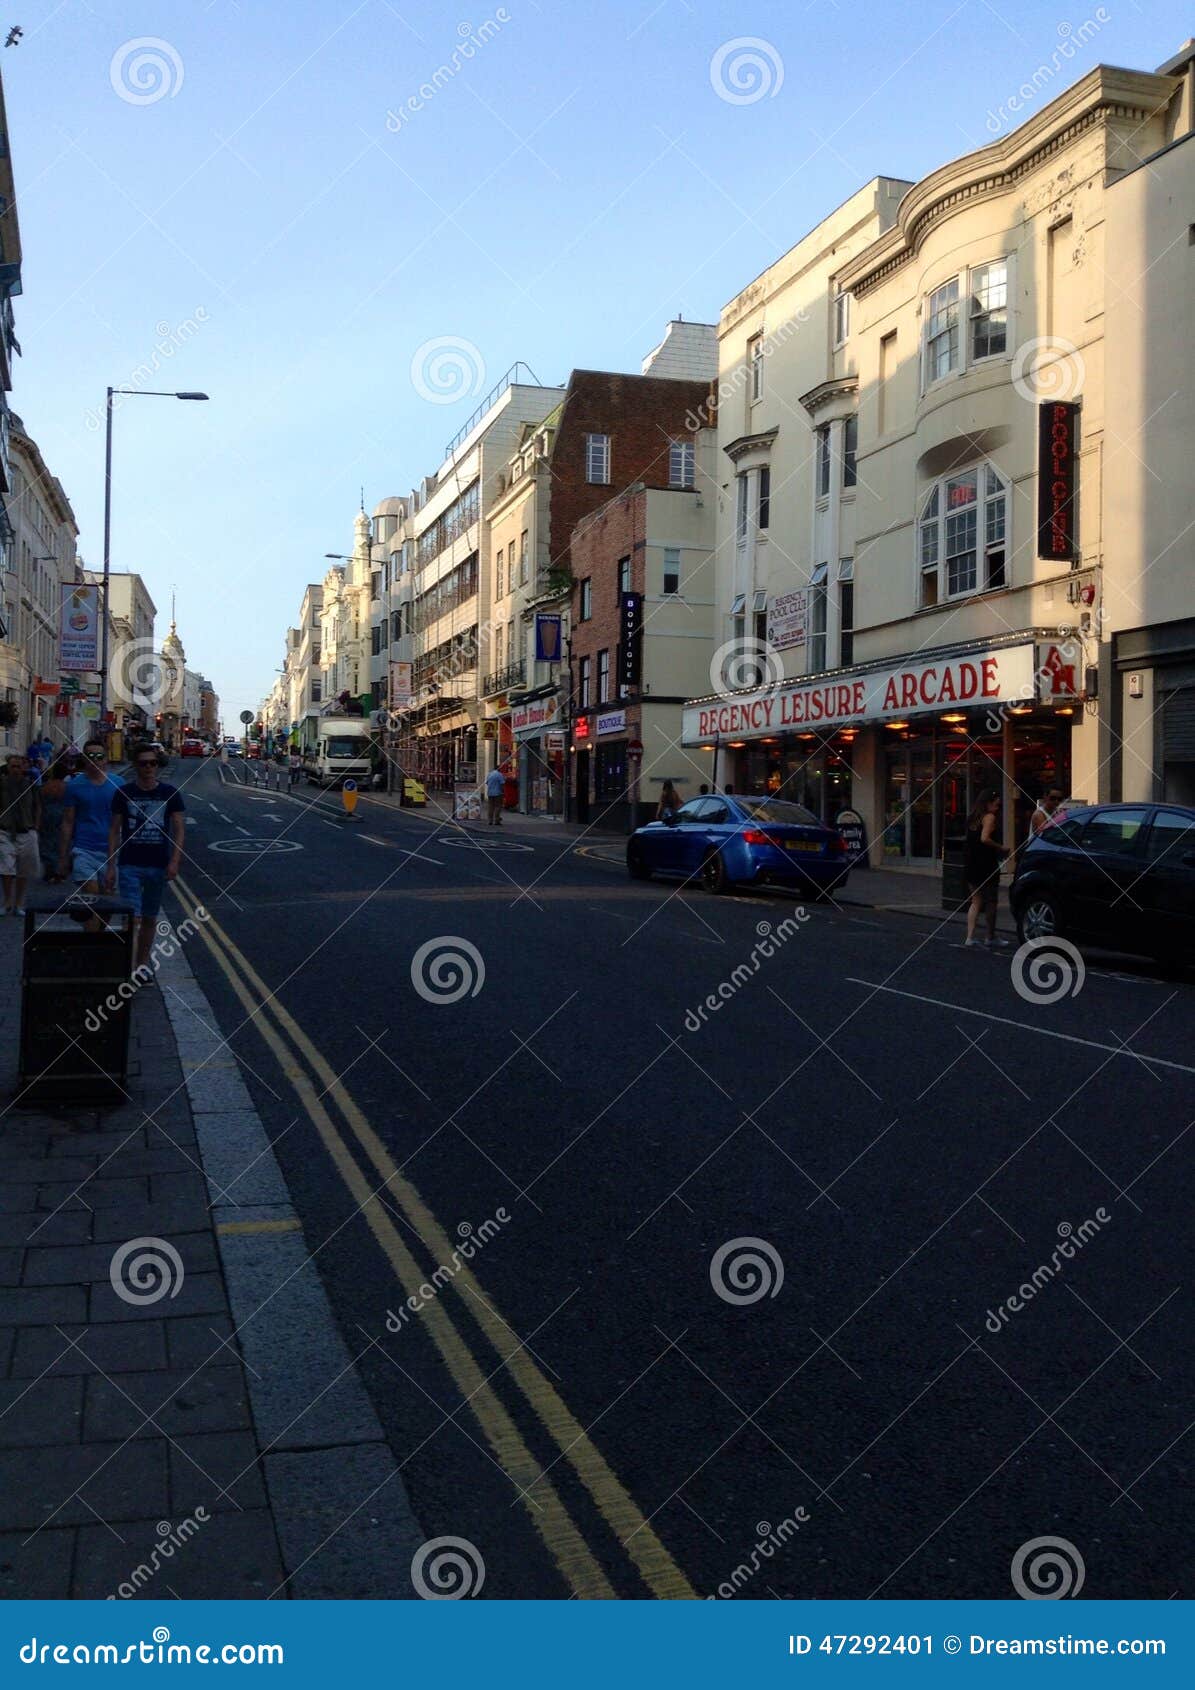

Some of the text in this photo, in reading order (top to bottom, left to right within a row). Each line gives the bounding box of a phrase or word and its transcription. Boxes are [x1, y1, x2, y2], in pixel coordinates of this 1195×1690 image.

[1052, 406, 1068, 476] POOL
[626, 600, 634, 678] BOUTIQUE
[699, 657, 1001, 736] REGENCY LEISURE ARCADE
